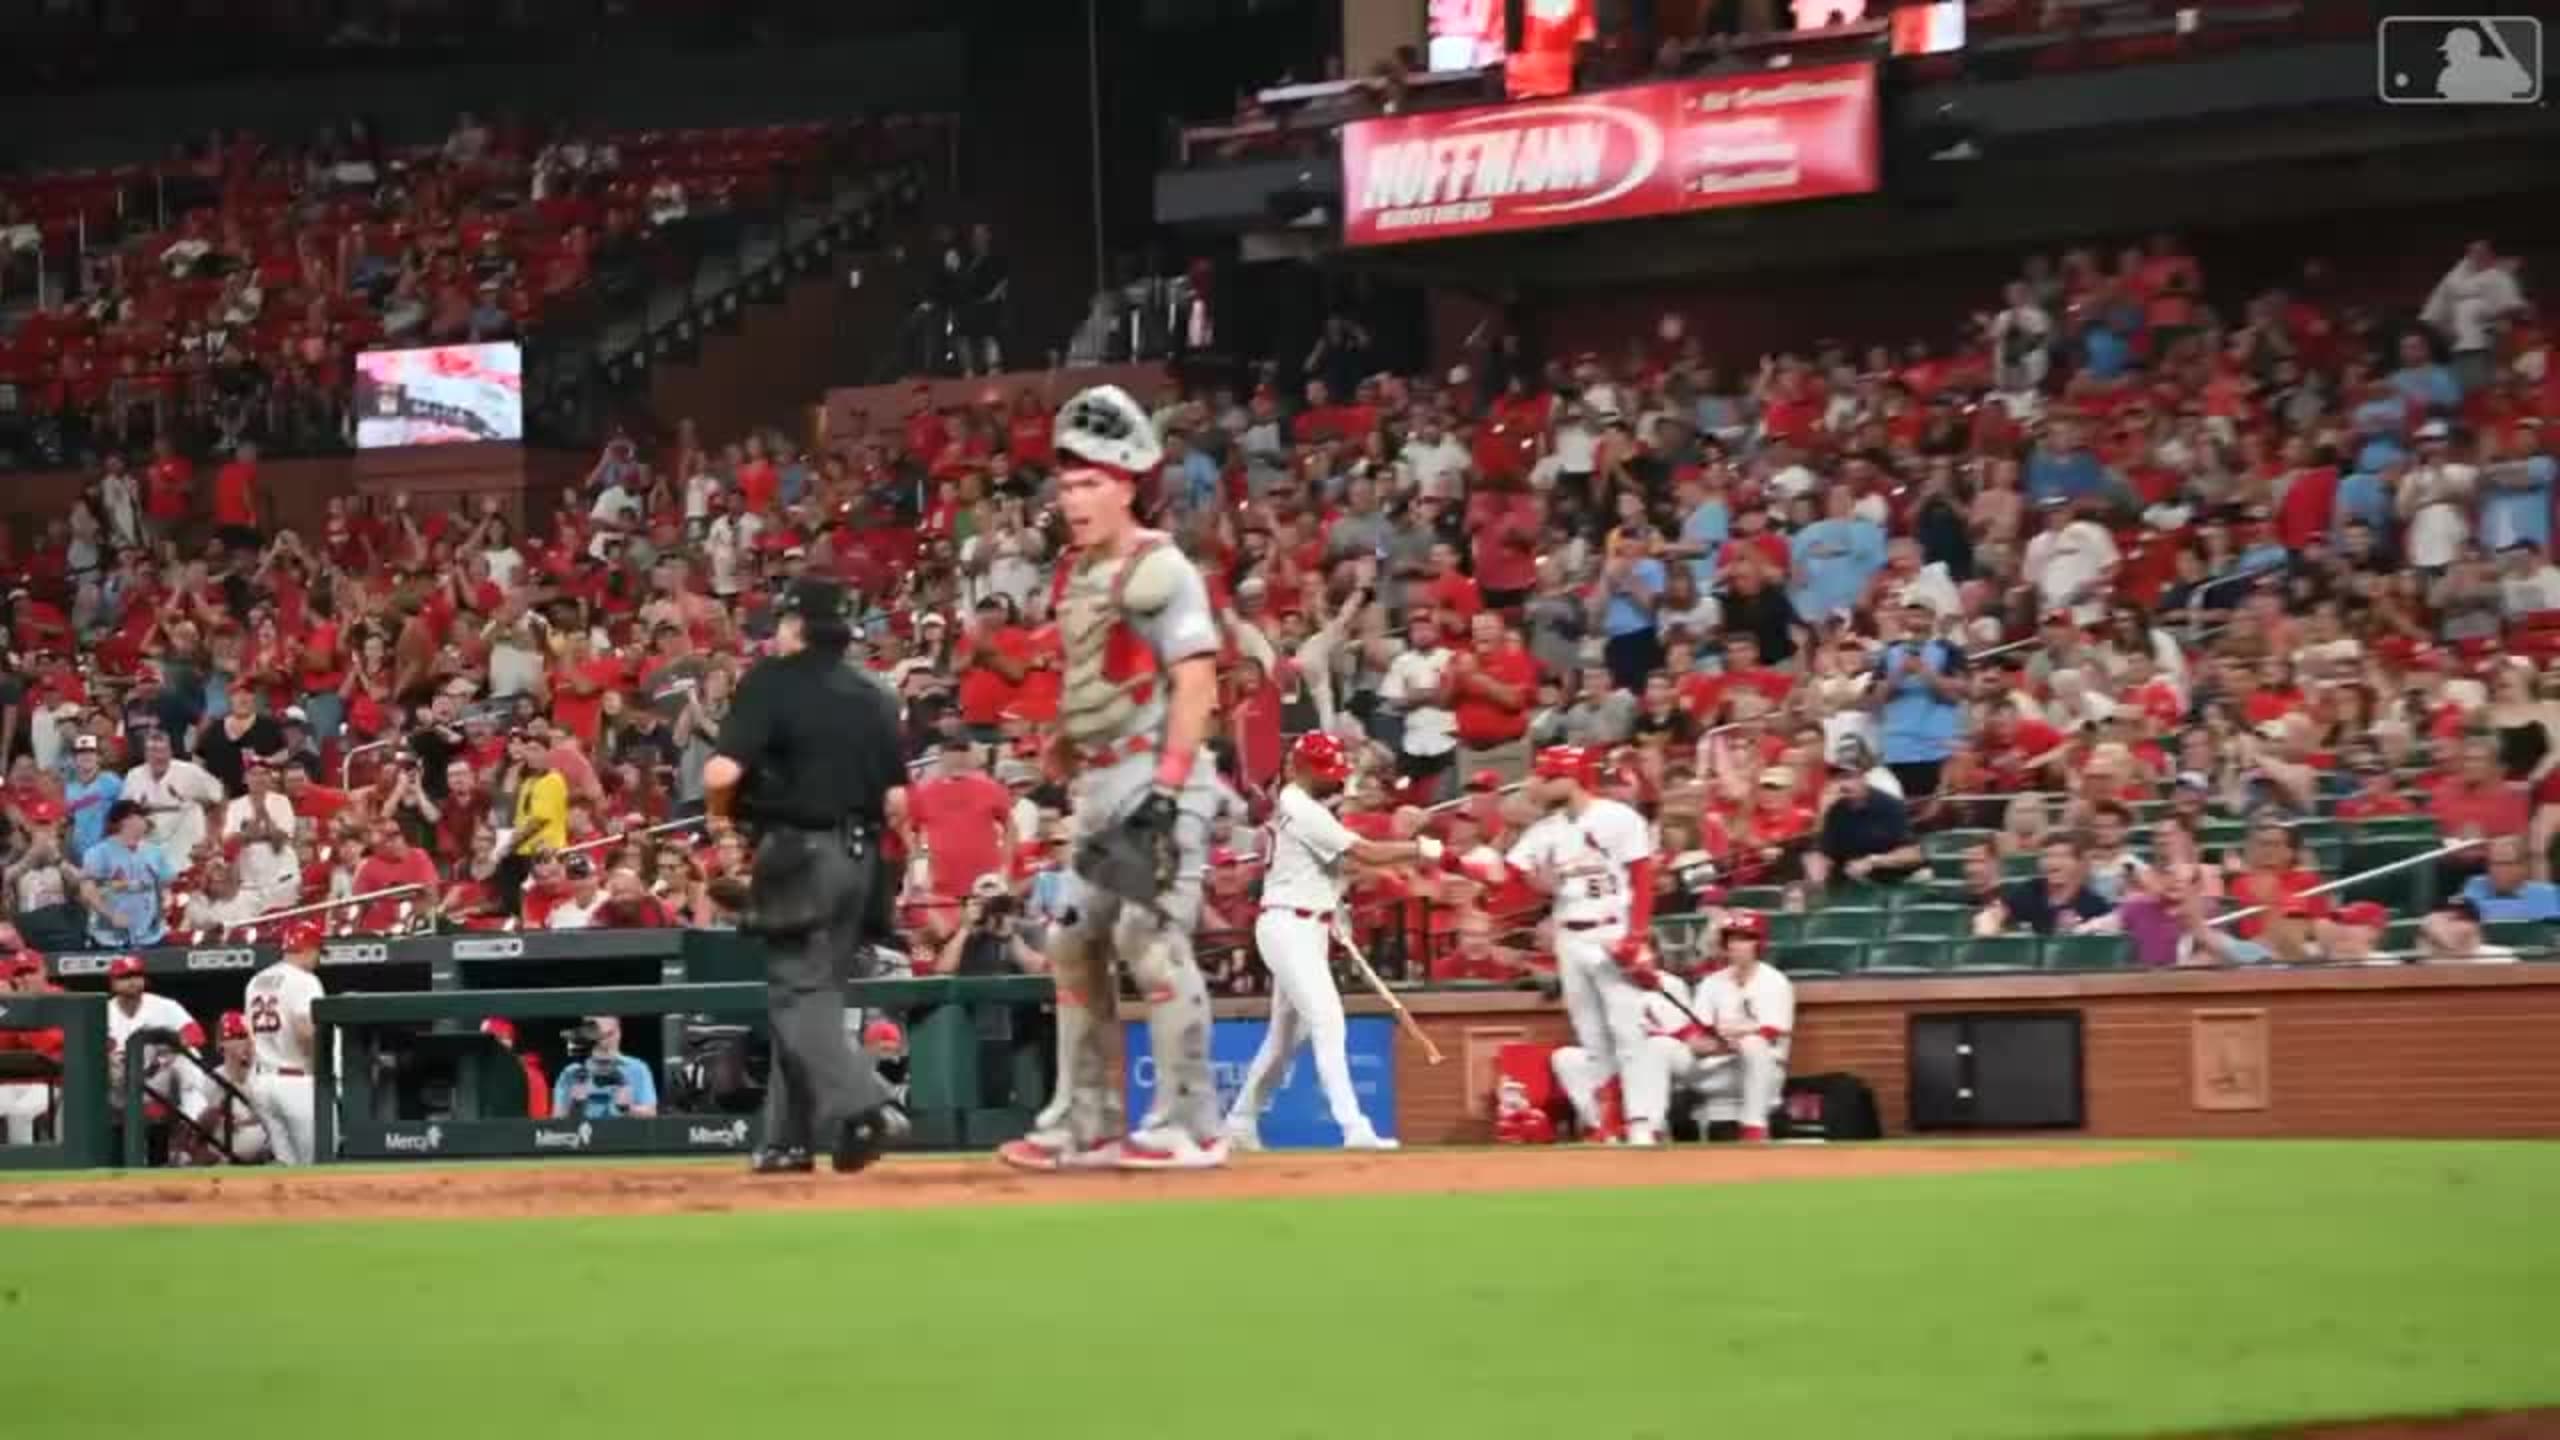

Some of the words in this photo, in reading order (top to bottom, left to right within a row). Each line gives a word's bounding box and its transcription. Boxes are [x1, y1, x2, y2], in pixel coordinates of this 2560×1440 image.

[1362, 120, 1608, 210] HOFFMANN
[58, 956, 113, 975] GEIC
[186, 949, 255, 969] GEICO
[386, 1132, 428, 1151] Mercy
